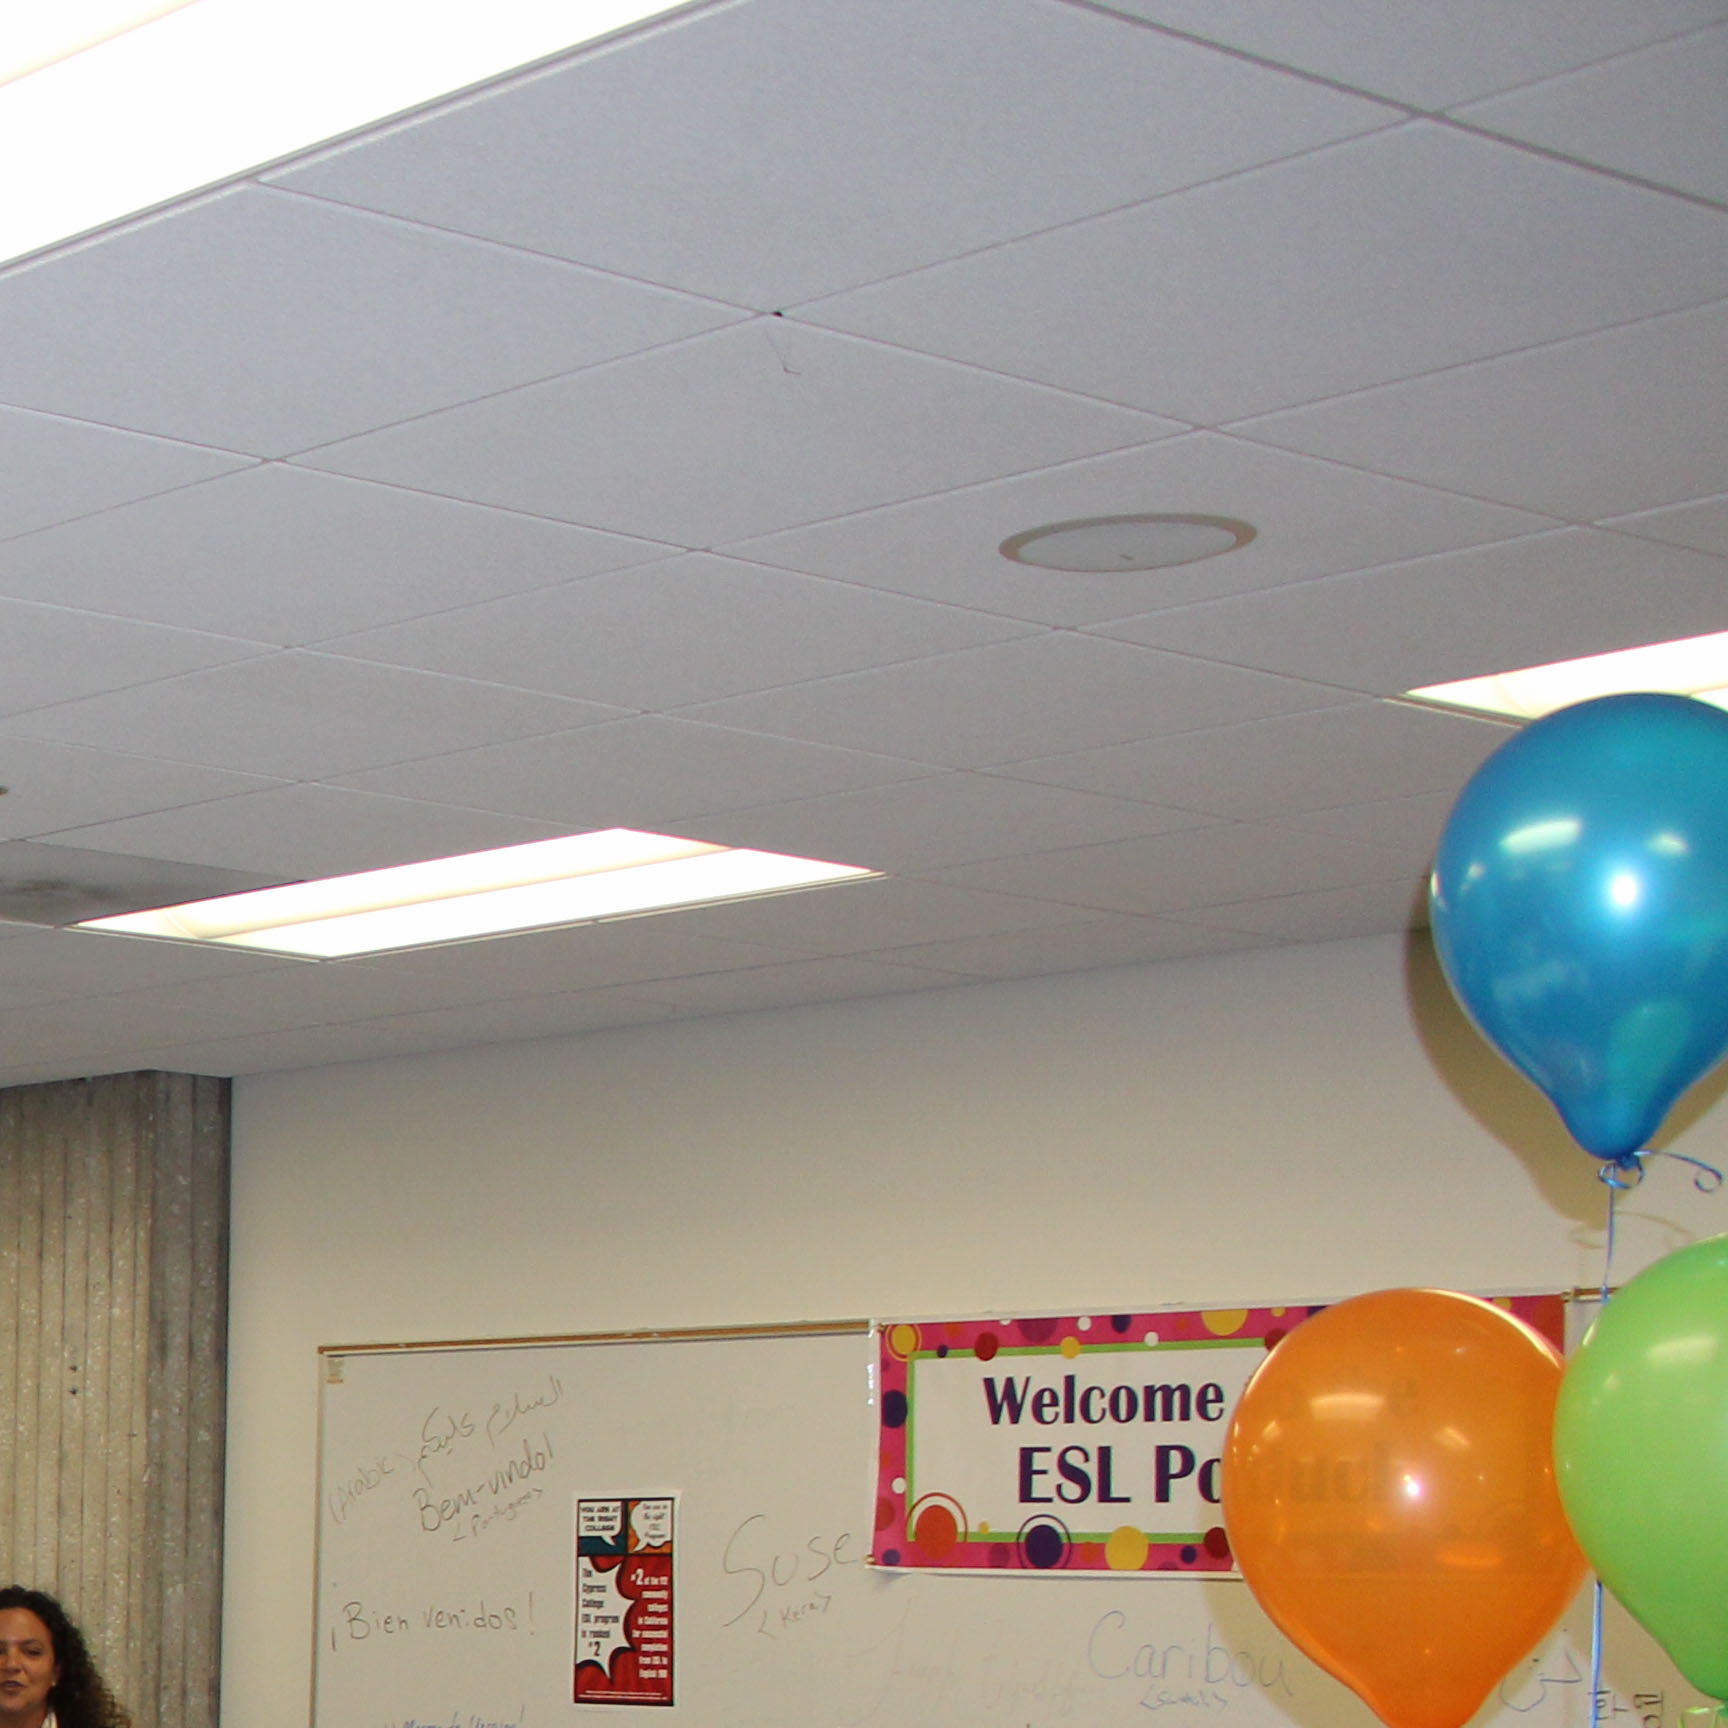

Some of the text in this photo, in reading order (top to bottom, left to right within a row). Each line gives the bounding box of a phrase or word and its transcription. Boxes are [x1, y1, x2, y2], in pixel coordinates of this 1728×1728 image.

[982, 1374, 1225, 1425] Welcome
[1018, 1445, 1132, 1504] ESL
[1087, 1609, 1296, 1697] Caribou
